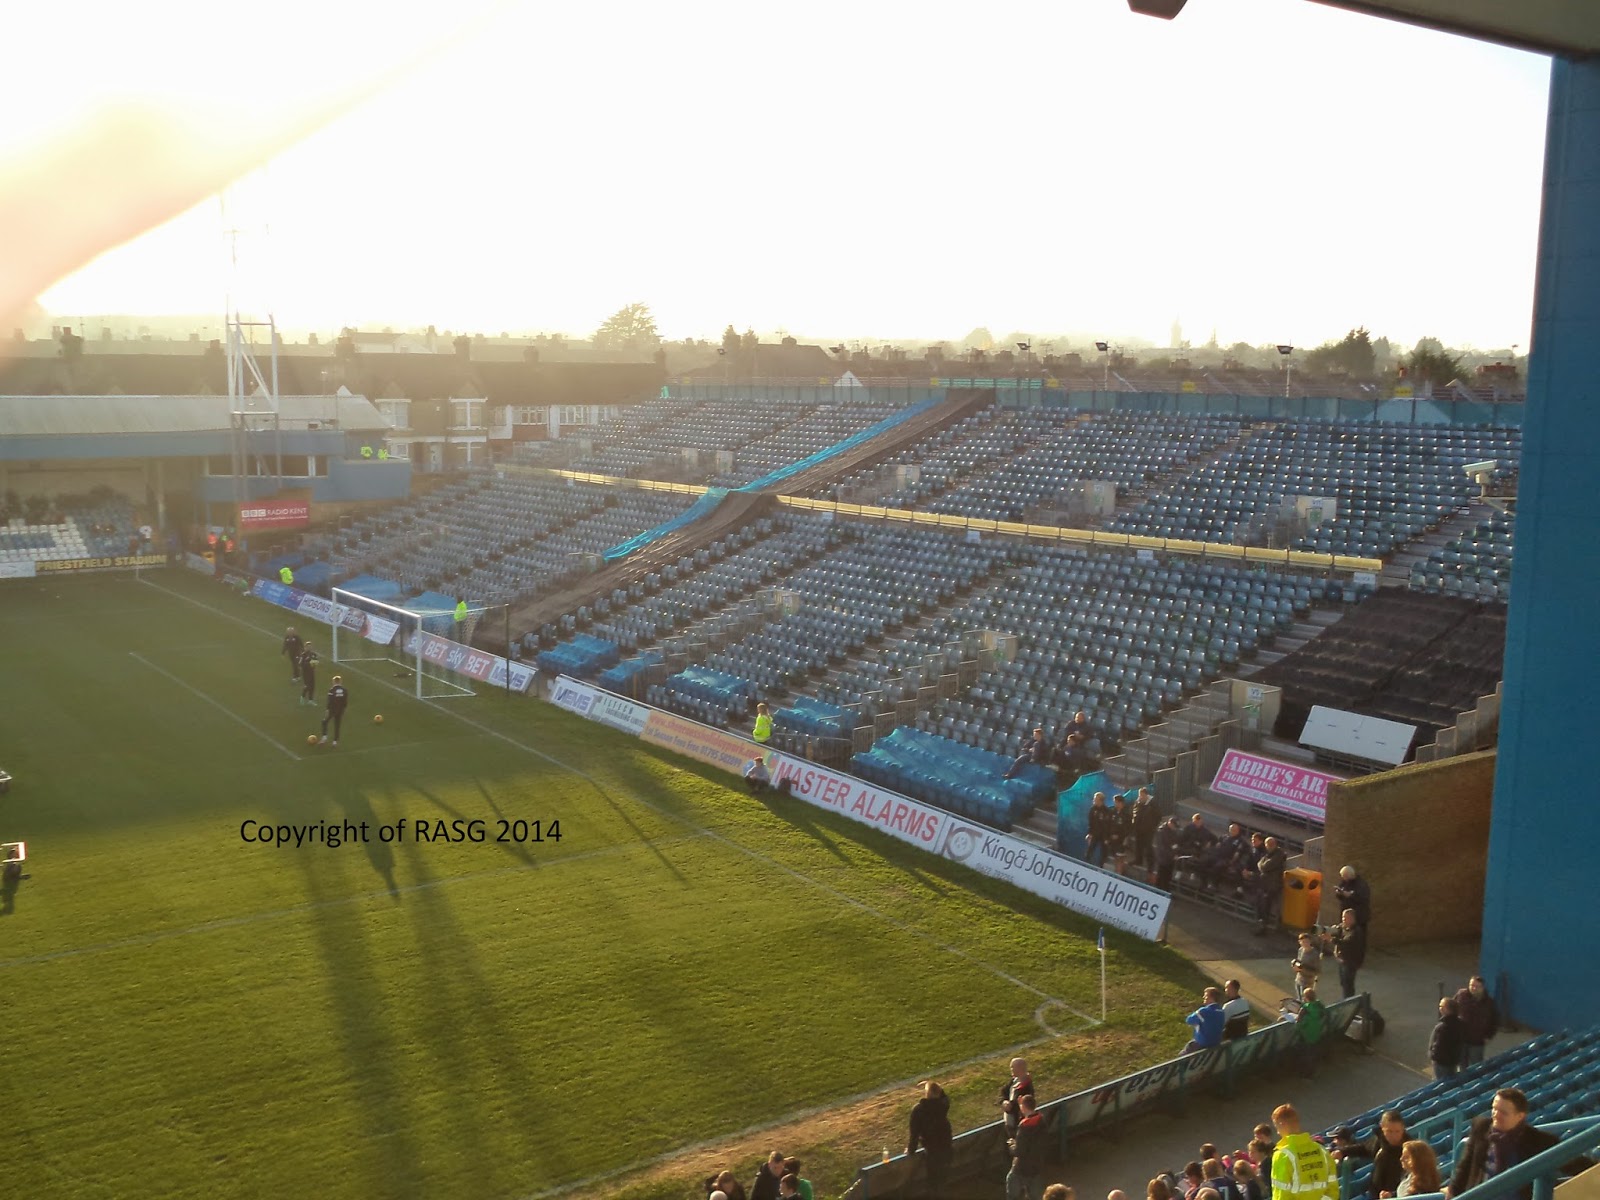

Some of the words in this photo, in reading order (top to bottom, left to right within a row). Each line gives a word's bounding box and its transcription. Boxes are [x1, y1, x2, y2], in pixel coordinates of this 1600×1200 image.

[241, 509, 266, 518] BBC
[267, 508, 289, 516] RADIO
[289, 507, 307, 515] KENT
[36, 559, 112, 571] PRIESTFIELD
[115, 555, 167, 566] STADIUM
[425, 640, 449, 660] BET
[447, 647, 467, 669] sky
[464, 655, 490, 676] BET
[1222, 771, 1251, 785] FIGHT
[1250, 779, 1276, 791] KIDS
[1274, 784, 1306, 801] BRAIN
[1305, 793, 1327, 806] CAN
[1225, 756, 1296, 785] ABBIE'S
[1296, 774, 1327, 795] AR
[775, 761, 851, 808] MASTER
[851, 790, 939, 842] ALARMS
[1102, 881, 1160, 921] Homes
